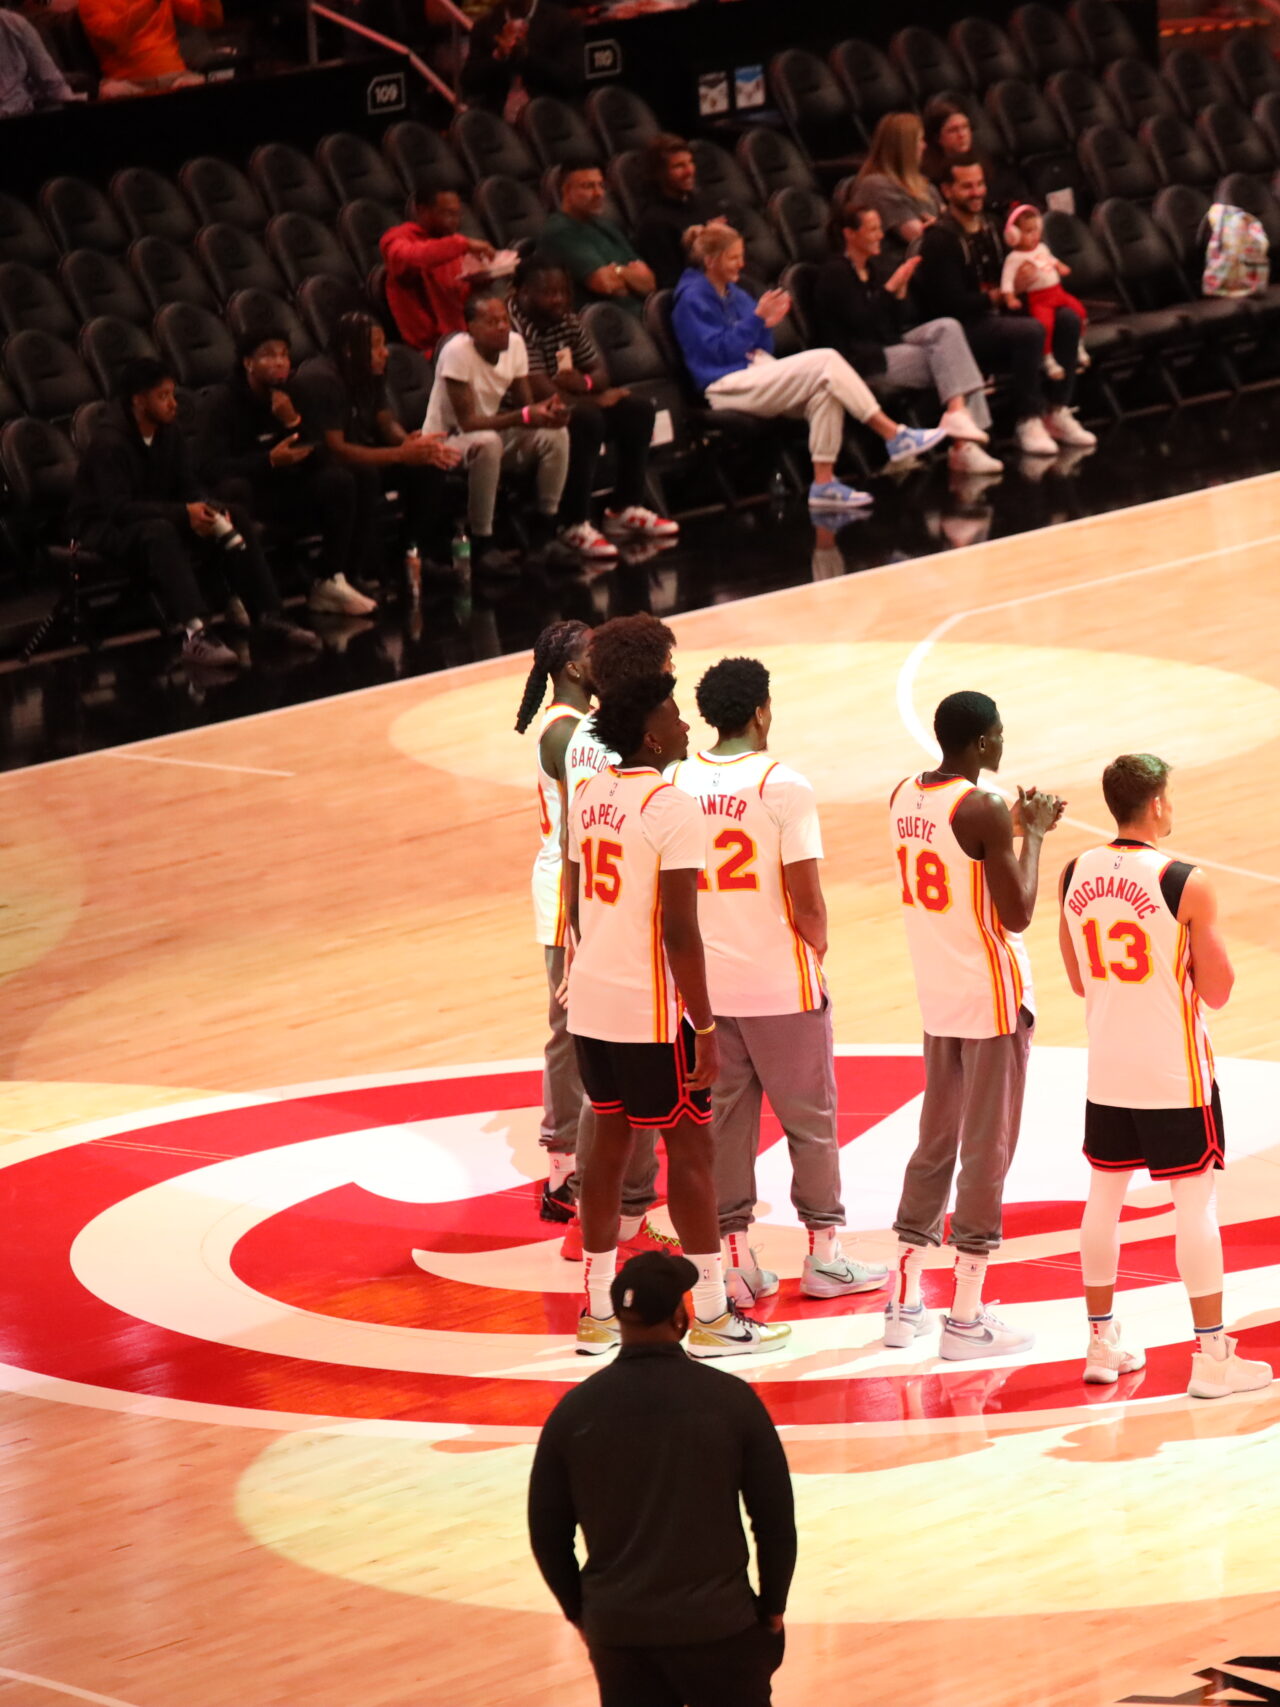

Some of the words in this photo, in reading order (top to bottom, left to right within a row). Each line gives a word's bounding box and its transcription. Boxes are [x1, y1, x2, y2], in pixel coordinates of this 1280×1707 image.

[374, 84, 398, 103] 109
[581, 804, 626, 834] CAPELA
[896, 816, 936, 844] GUEYE
[581, 837, 624, 905] 15
[896, 844, 953, 914] 18
[1070, 876, 1160, 919] BOGDANOVIĆ
[1081, 917, 1154, 984] 13
